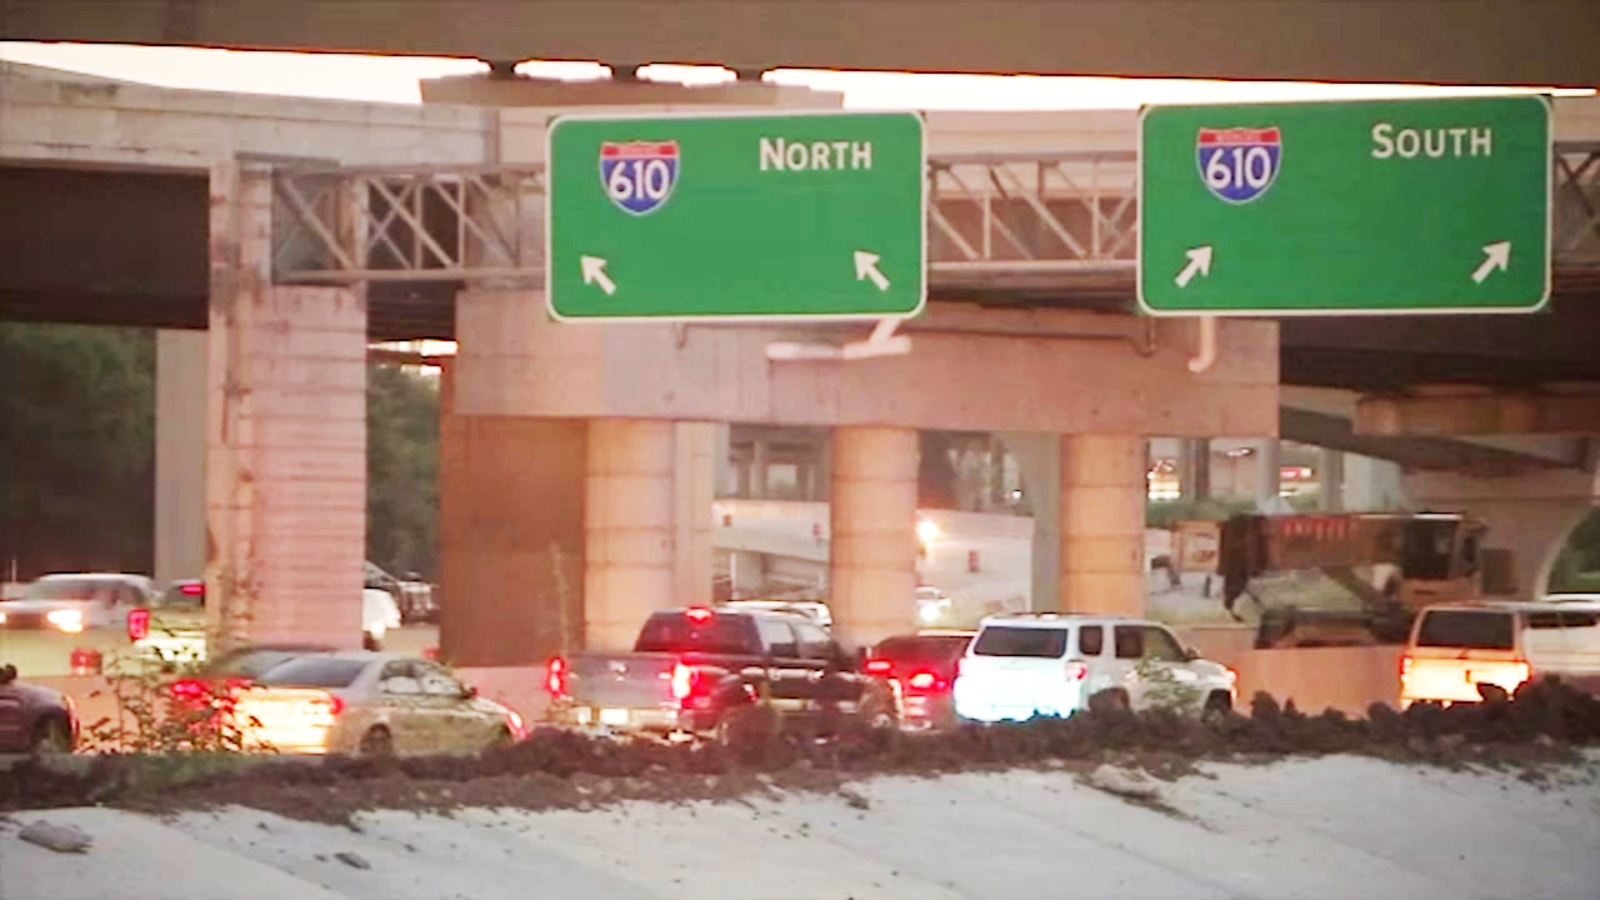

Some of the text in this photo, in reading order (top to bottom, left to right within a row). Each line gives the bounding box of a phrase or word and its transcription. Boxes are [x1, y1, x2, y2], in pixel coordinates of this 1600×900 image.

[760, 137, 872, 171] NORTH
[1372, 123, 1492, 159] SOUTH
[608, 160, 670, 200] 610
[1206, 146, 1271, 189] 610
